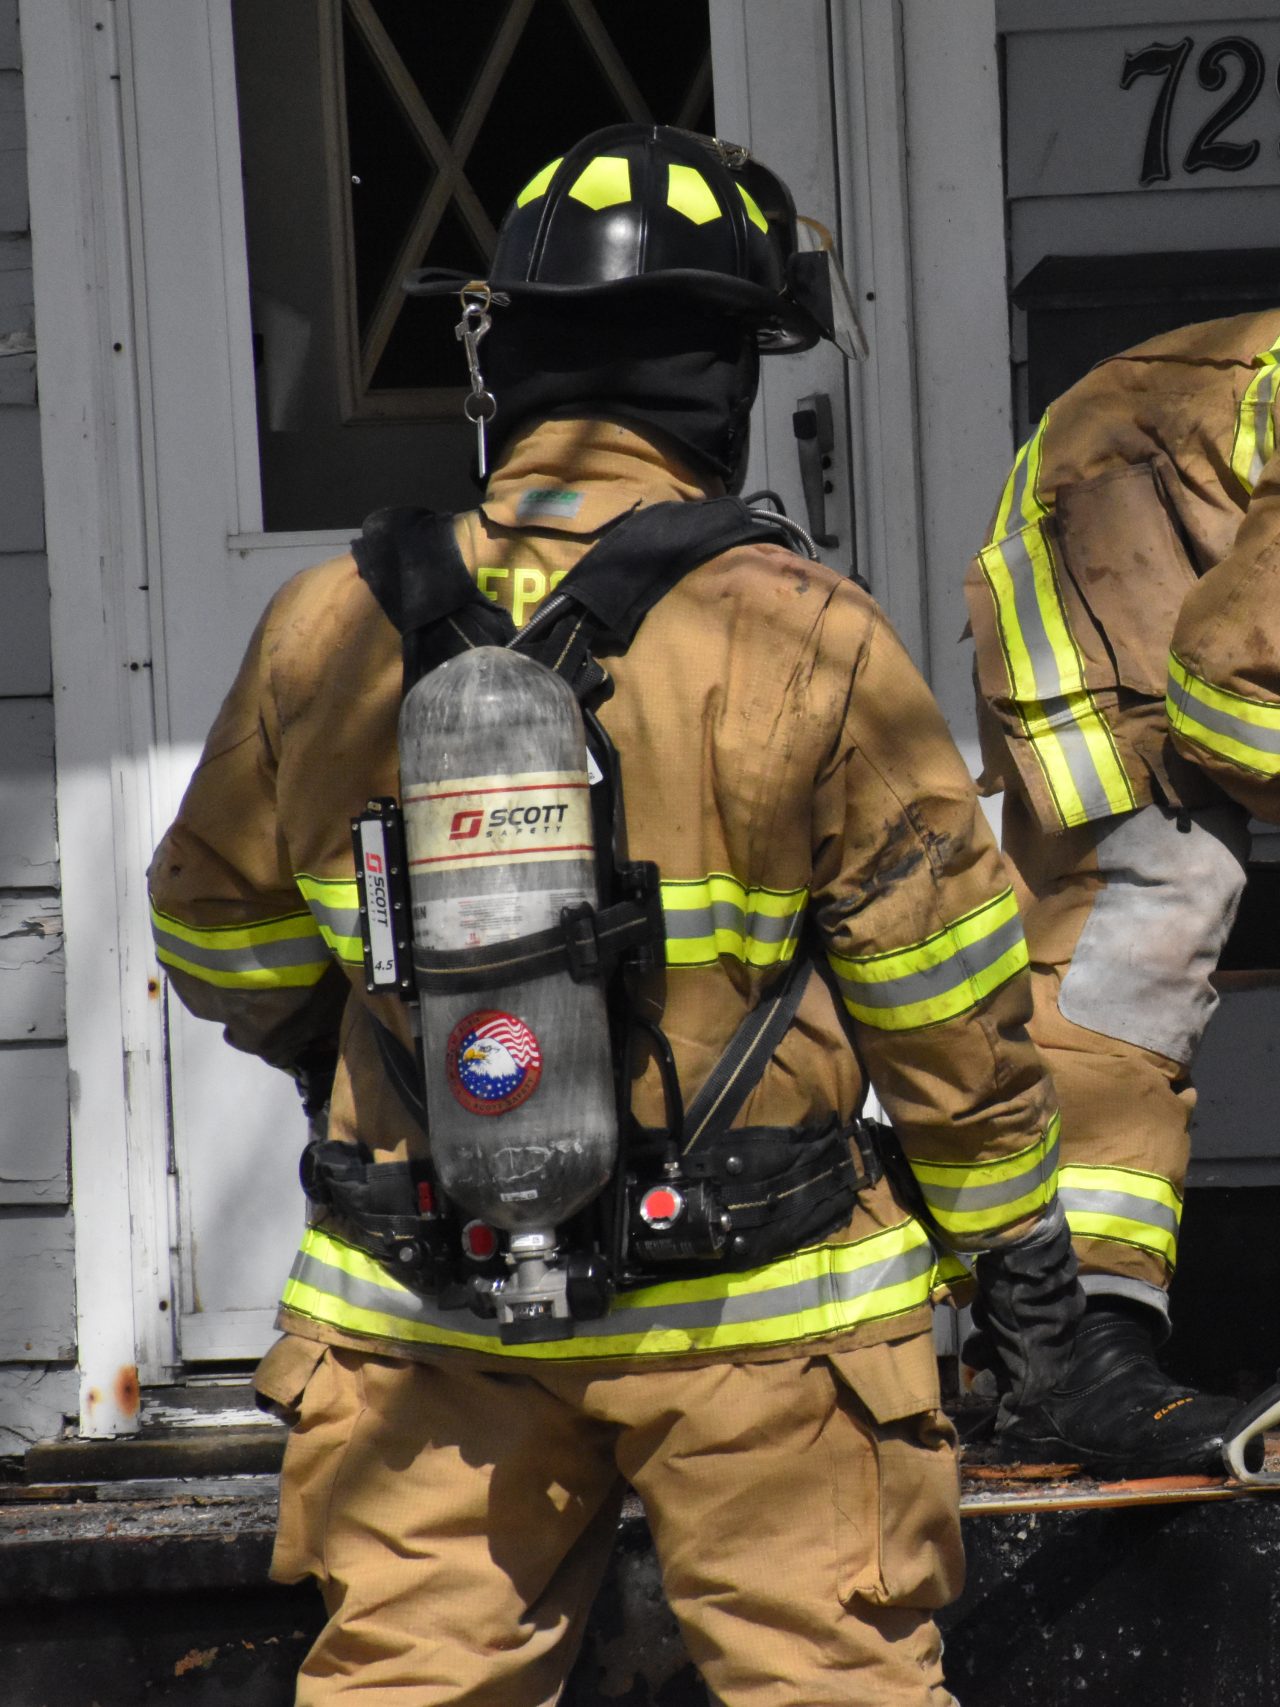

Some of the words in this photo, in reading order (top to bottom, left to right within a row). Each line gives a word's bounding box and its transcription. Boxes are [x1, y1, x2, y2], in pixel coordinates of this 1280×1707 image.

[488, 804, 569, 828] SCOTT
[486, 826, 563, 838] SAFETY
[375, 876, 388, 927] SCOTT
[374, 960, 394, 971] 4.5
